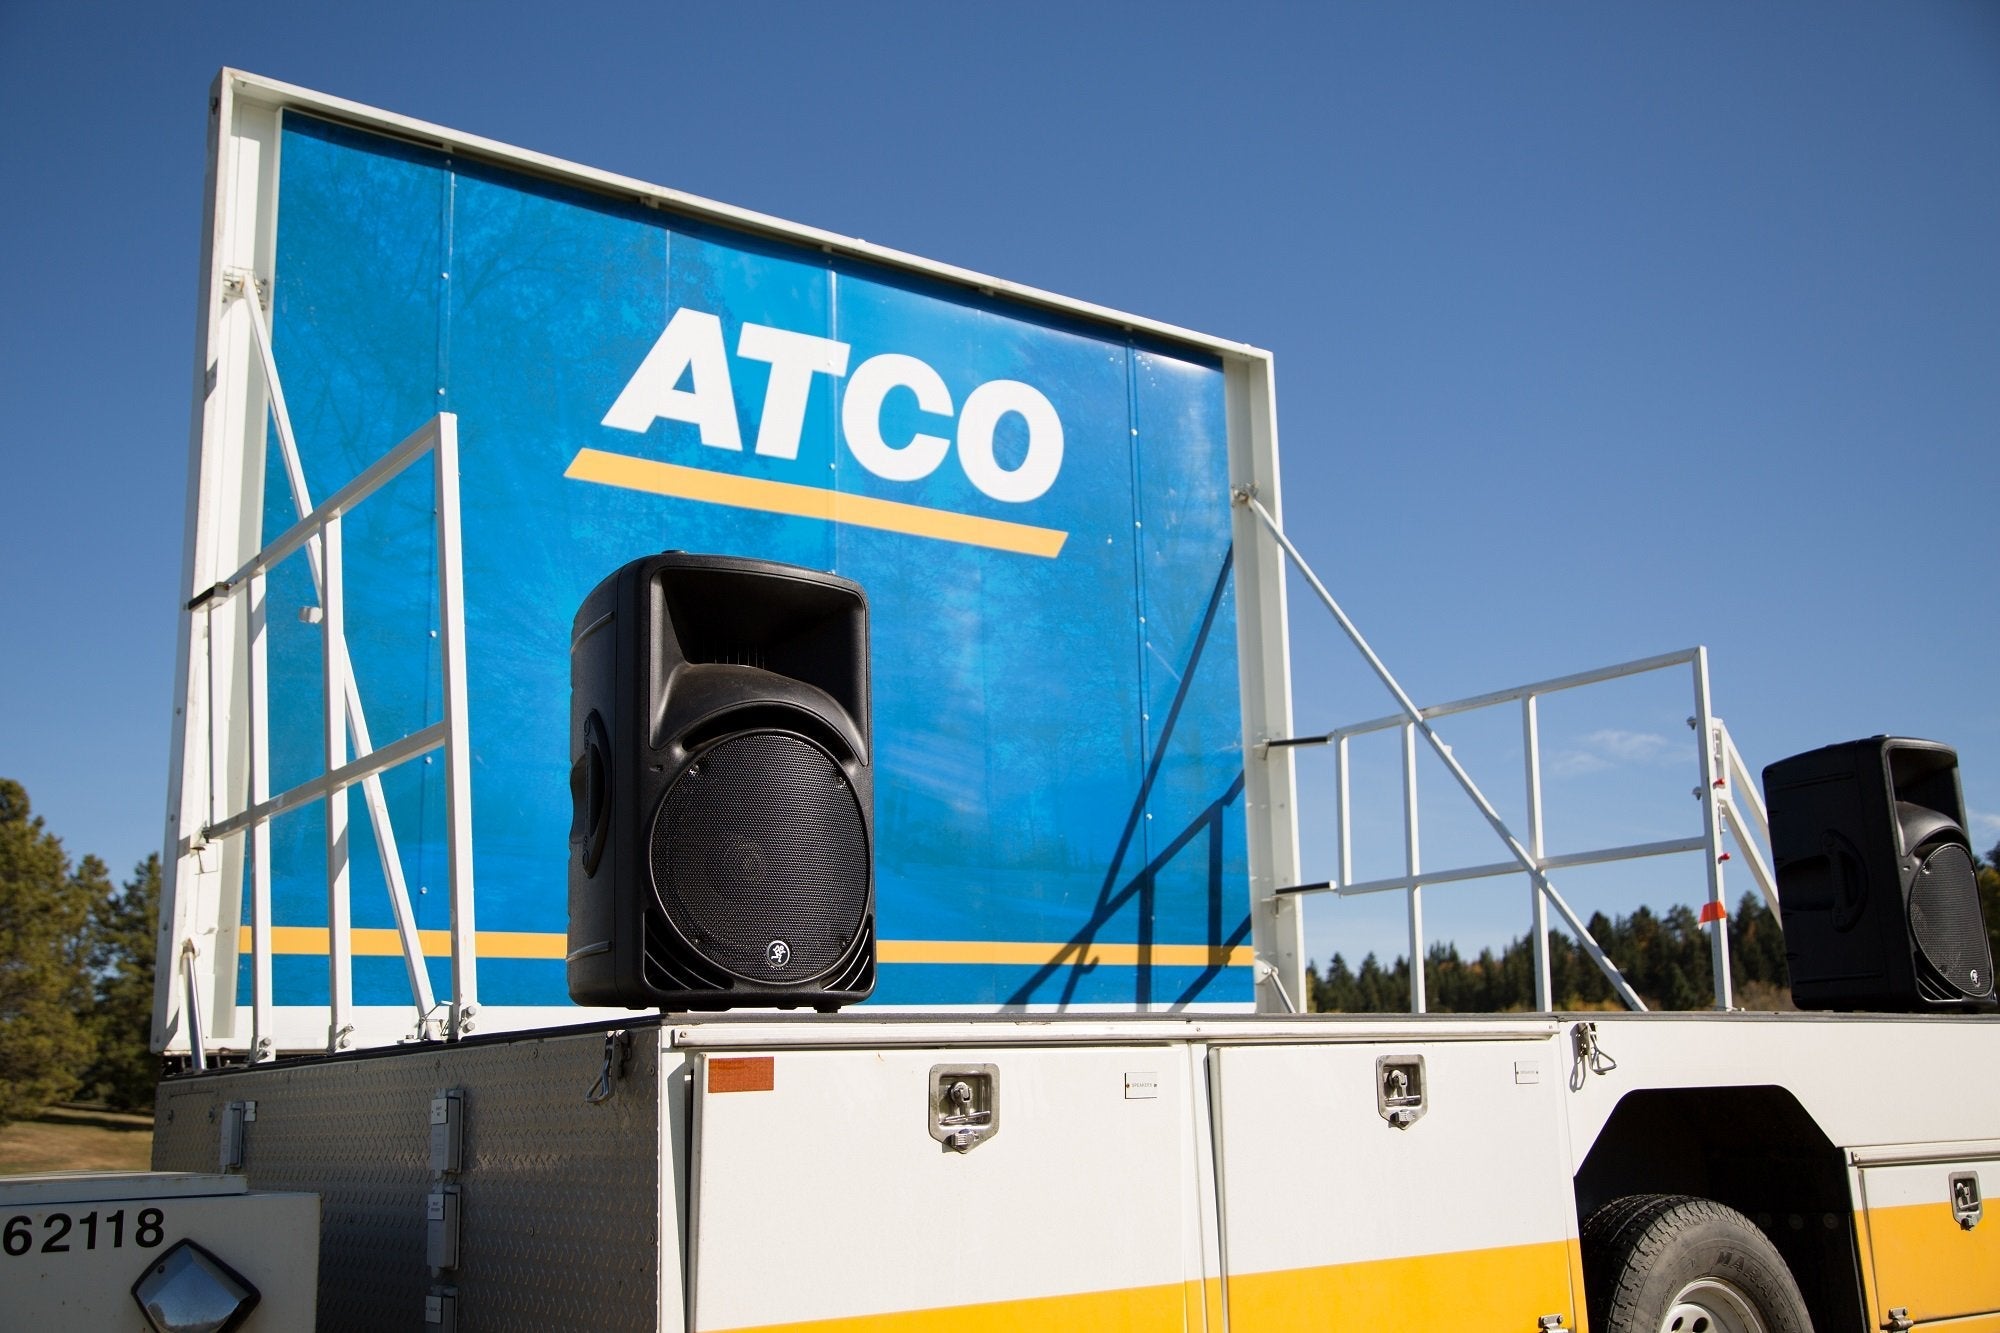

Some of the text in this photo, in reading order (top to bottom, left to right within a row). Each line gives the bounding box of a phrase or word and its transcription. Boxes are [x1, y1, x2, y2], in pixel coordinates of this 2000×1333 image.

[601, 307, 1065, 504] ATCO
[2, 1207, 165, 1256] 62118
[1715, 1251, 1799, 1333] MARATH
